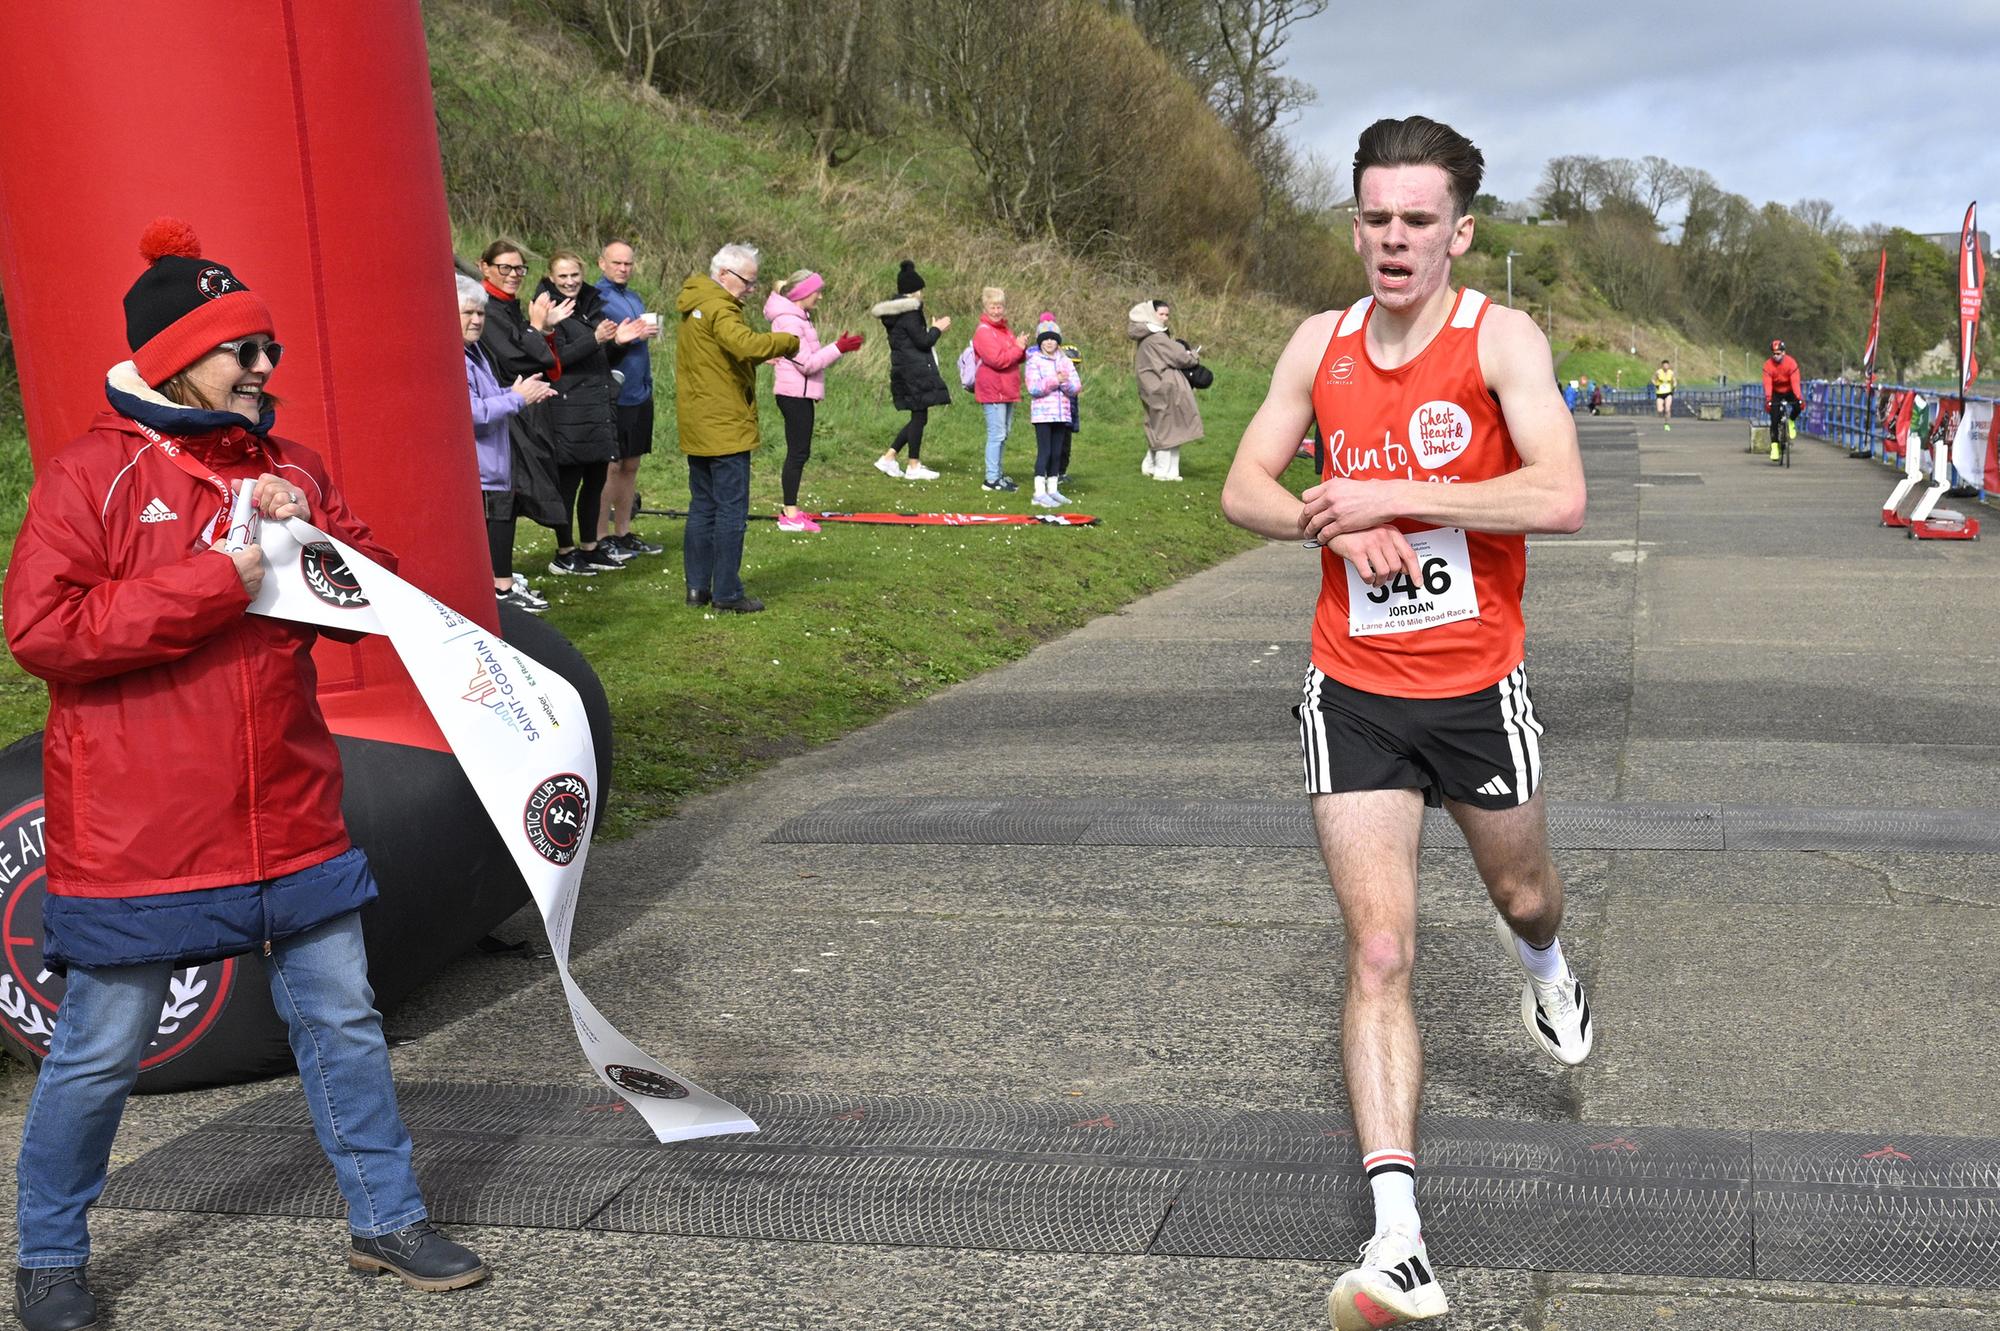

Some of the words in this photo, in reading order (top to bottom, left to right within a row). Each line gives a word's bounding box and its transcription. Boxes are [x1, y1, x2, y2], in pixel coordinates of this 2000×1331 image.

[1419, 407, 1454, 426] Chest
[1420, 424, 1455, 440] Heart
[160, 436, 180, 457] AC
[1329, 429, 1381, 476] Run
[1383, 431, 1408, 471] to
[1423, 440, 1461, 456] Stroke
[208, 475, 230, 504] Larne
[139, 511, 178, 523] adidas
[218, 506, 228, 524] AC
[1361, 622, 1383, 631] Larne
[1384, 620, 1395, 629] AC
[1397, 619, 1405, 628] 10
[1406, 617, 1423, 626] Mile
[1425, 611, 1445, 623] Road
[1446, 608, 1467, 618] Race
[1389, 601, 1434, 617] JORDAN
[474, 640, 540, 741] SAINT-GOBAIN
[538, 696, 556, 723] weber
[531, 781, 556, 809] CLUB
[527, 811, 555, 857] ATHLETIC
